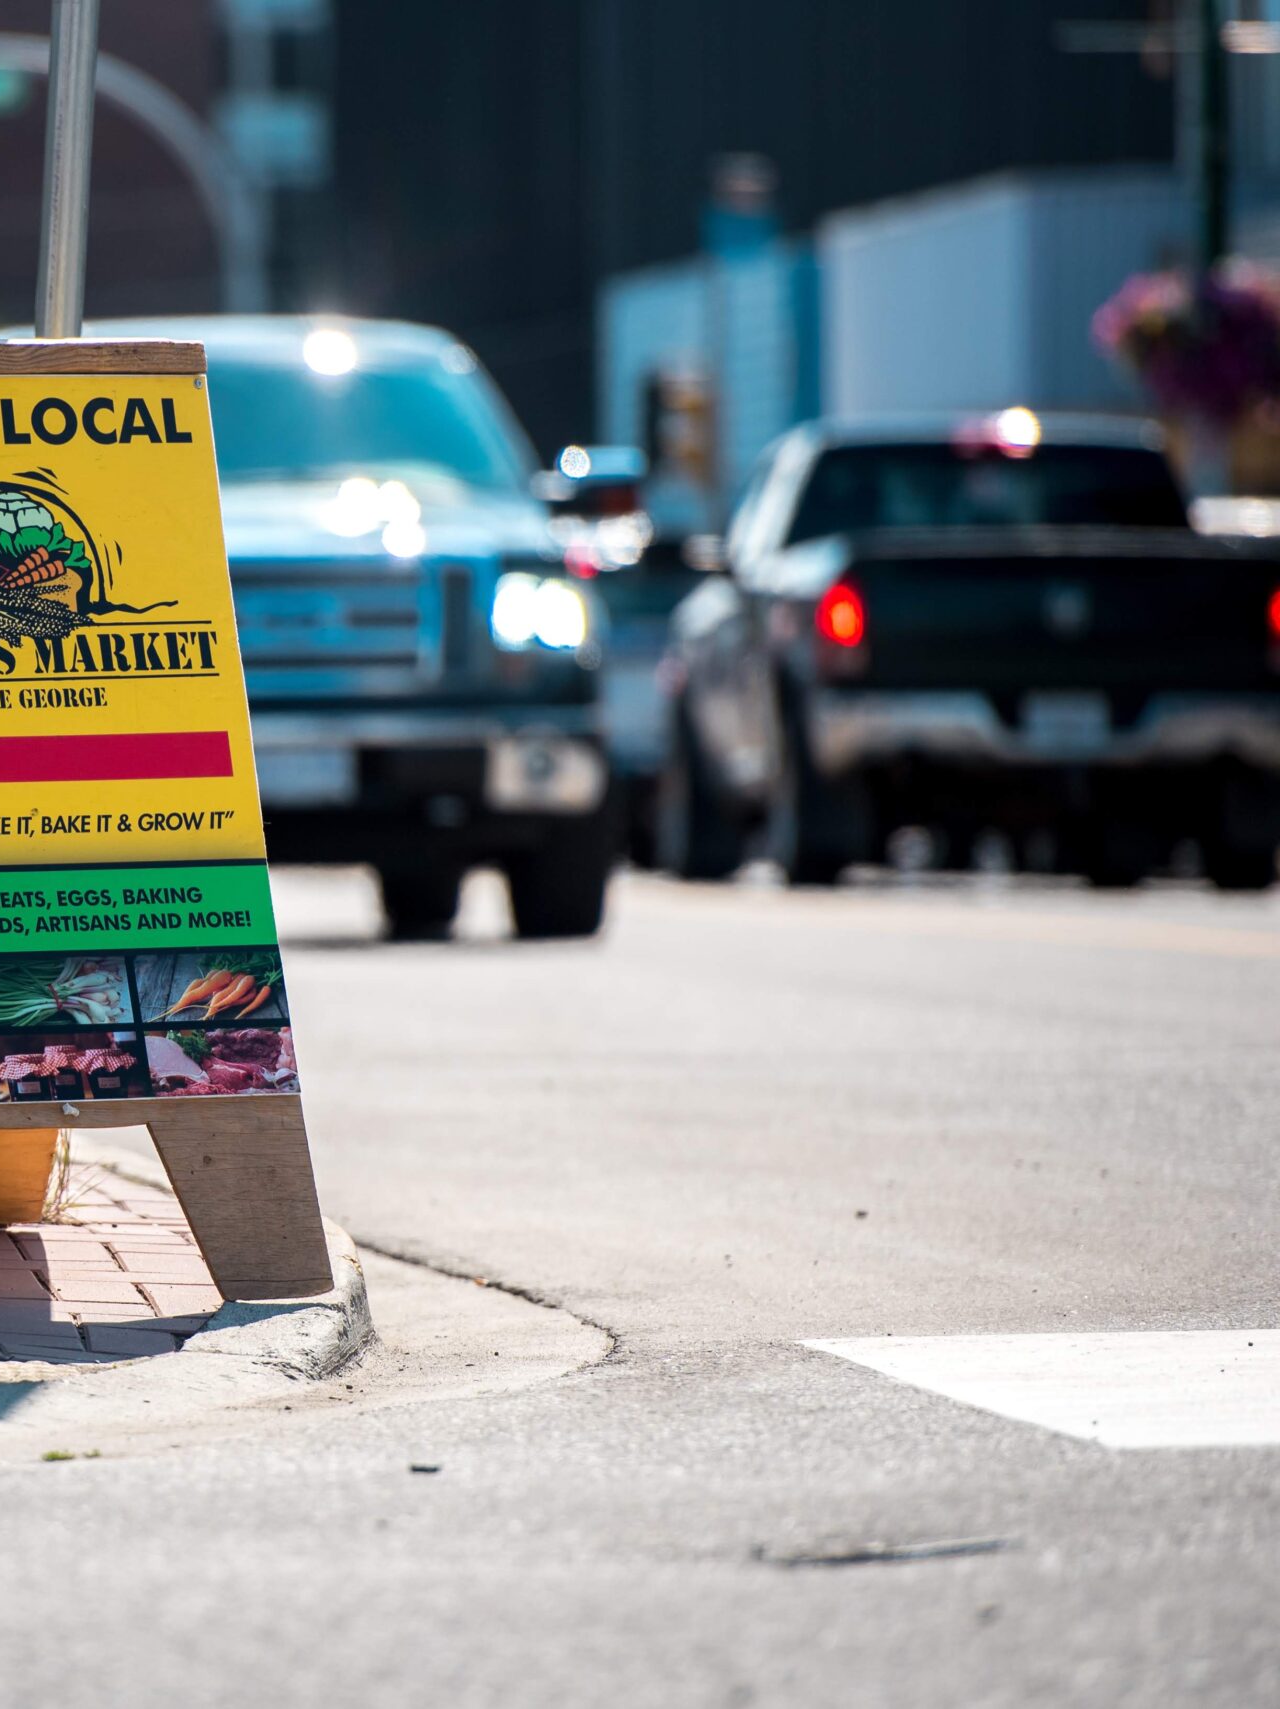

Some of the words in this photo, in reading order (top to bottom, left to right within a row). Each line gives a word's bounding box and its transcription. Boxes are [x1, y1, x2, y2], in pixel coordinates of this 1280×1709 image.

[0, 397, 193, 446] LOCAL
[34, 631, 218, 674] MARKET
[19, 687, 108, 709] GEORGE
[17, 816, 35, 838] IT,
[41, 815, 91, 834] BAKE
[96, 814, 112, 833] IT
[117, 813, 132, 832] &
[137, 812, 205, 832] GROW
[56, 889, 118, 908] EGGS,
[122, 886, 203, 905] BAKING
[35, 914, 132, 933] ARTISANS
[137, 913, 182, 930] AND
[188, 910, 252, 929] MORE!
